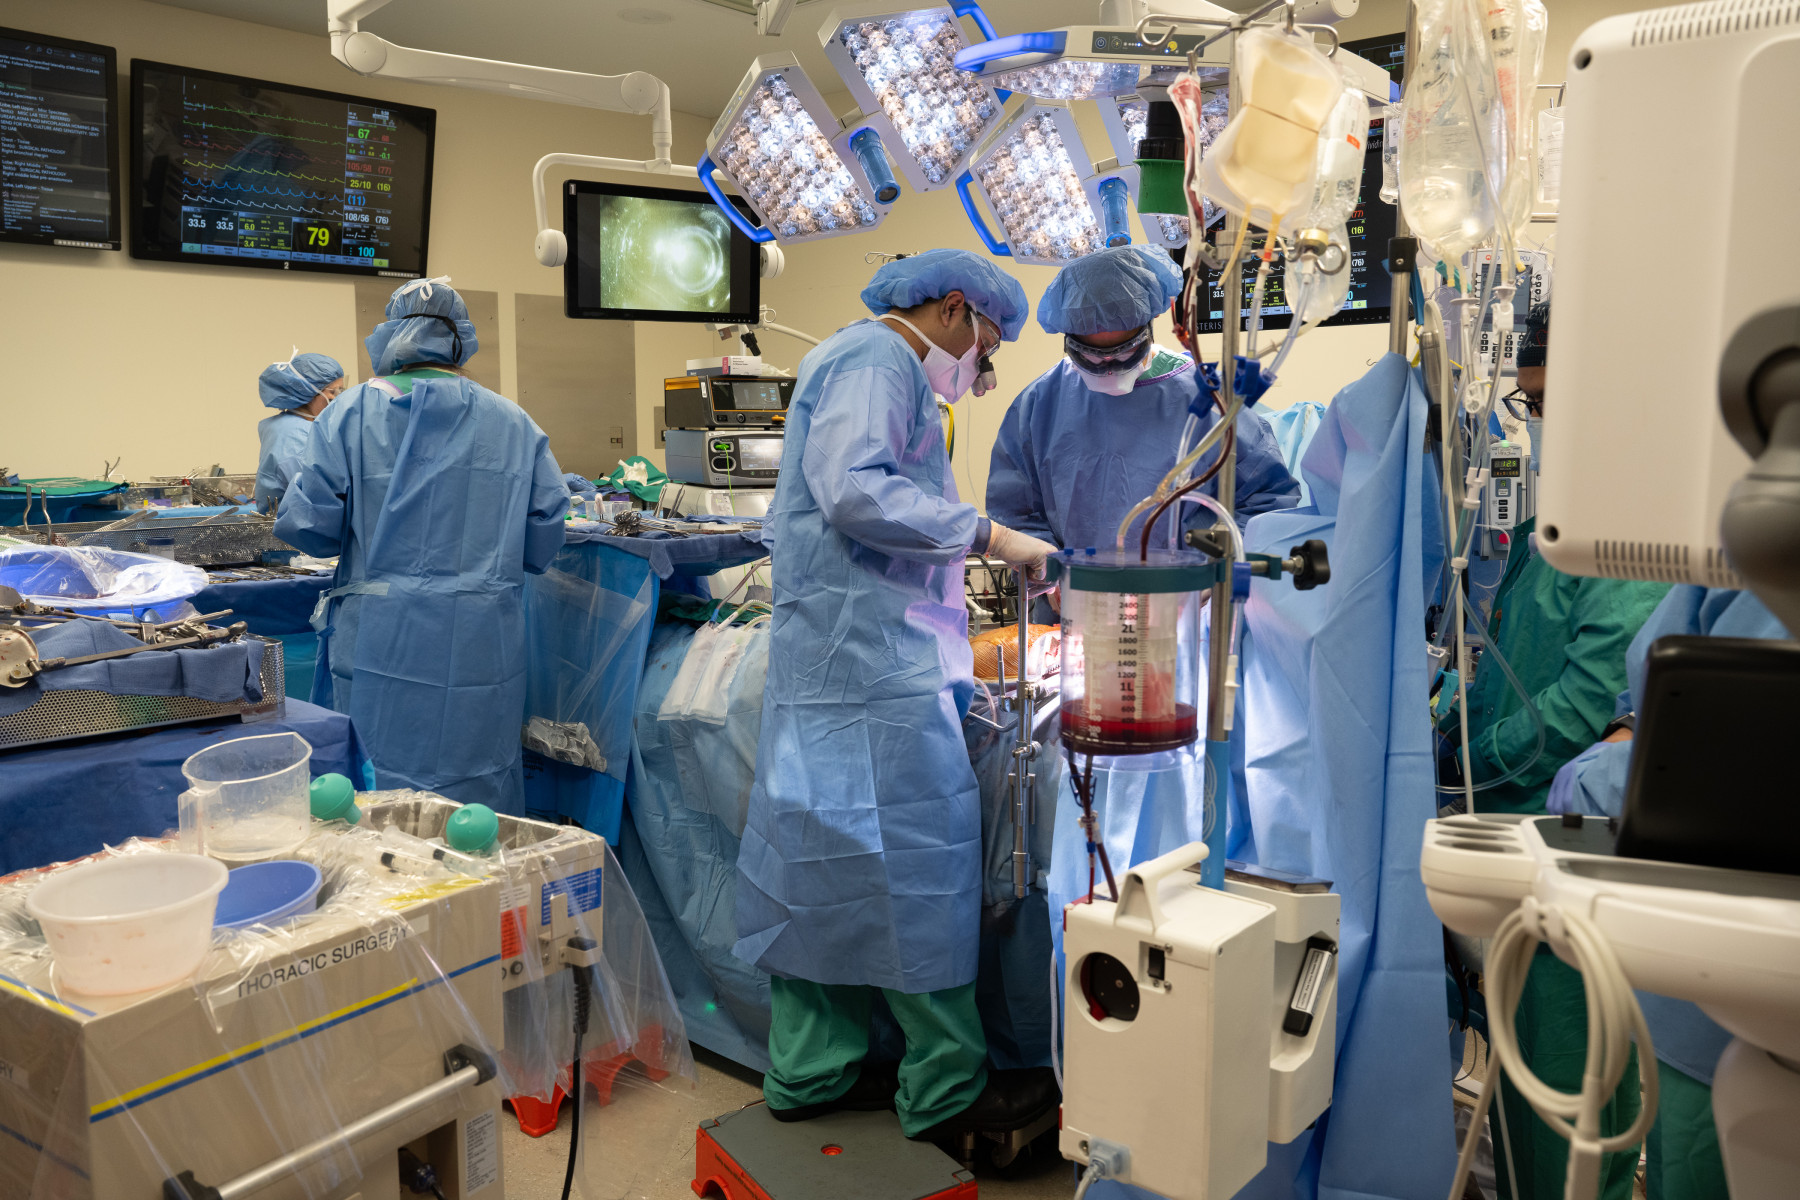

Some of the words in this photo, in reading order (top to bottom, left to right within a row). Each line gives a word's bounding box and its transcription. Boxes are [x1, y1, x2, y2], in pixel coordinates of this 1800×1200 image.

[358, 128, 370, 139] 67
[350, 179, 371, 189] 25/10
[348, 195, 366, 206] (11)
[188, 218, 206, 228] 33.5
[216, 221, 234, 230] 33.5
[345, 213, 369, 222] 108/56
[375, 216, 389, 224] (76)
[1352, 226, 1364, 234] (16)
[307, 226, 330, 246] 79
[358, 246, 374, 257] 100
[284, 262, 289, 270] 2
[1352, 258, 1364, 267] (76)
[1122, 625, 1135, 633] 2L
[1120, 683, 1133, 691] 1L
[236, 953, 327, 998] THORACIC
[332, 925, 408, 963] SURGERY
